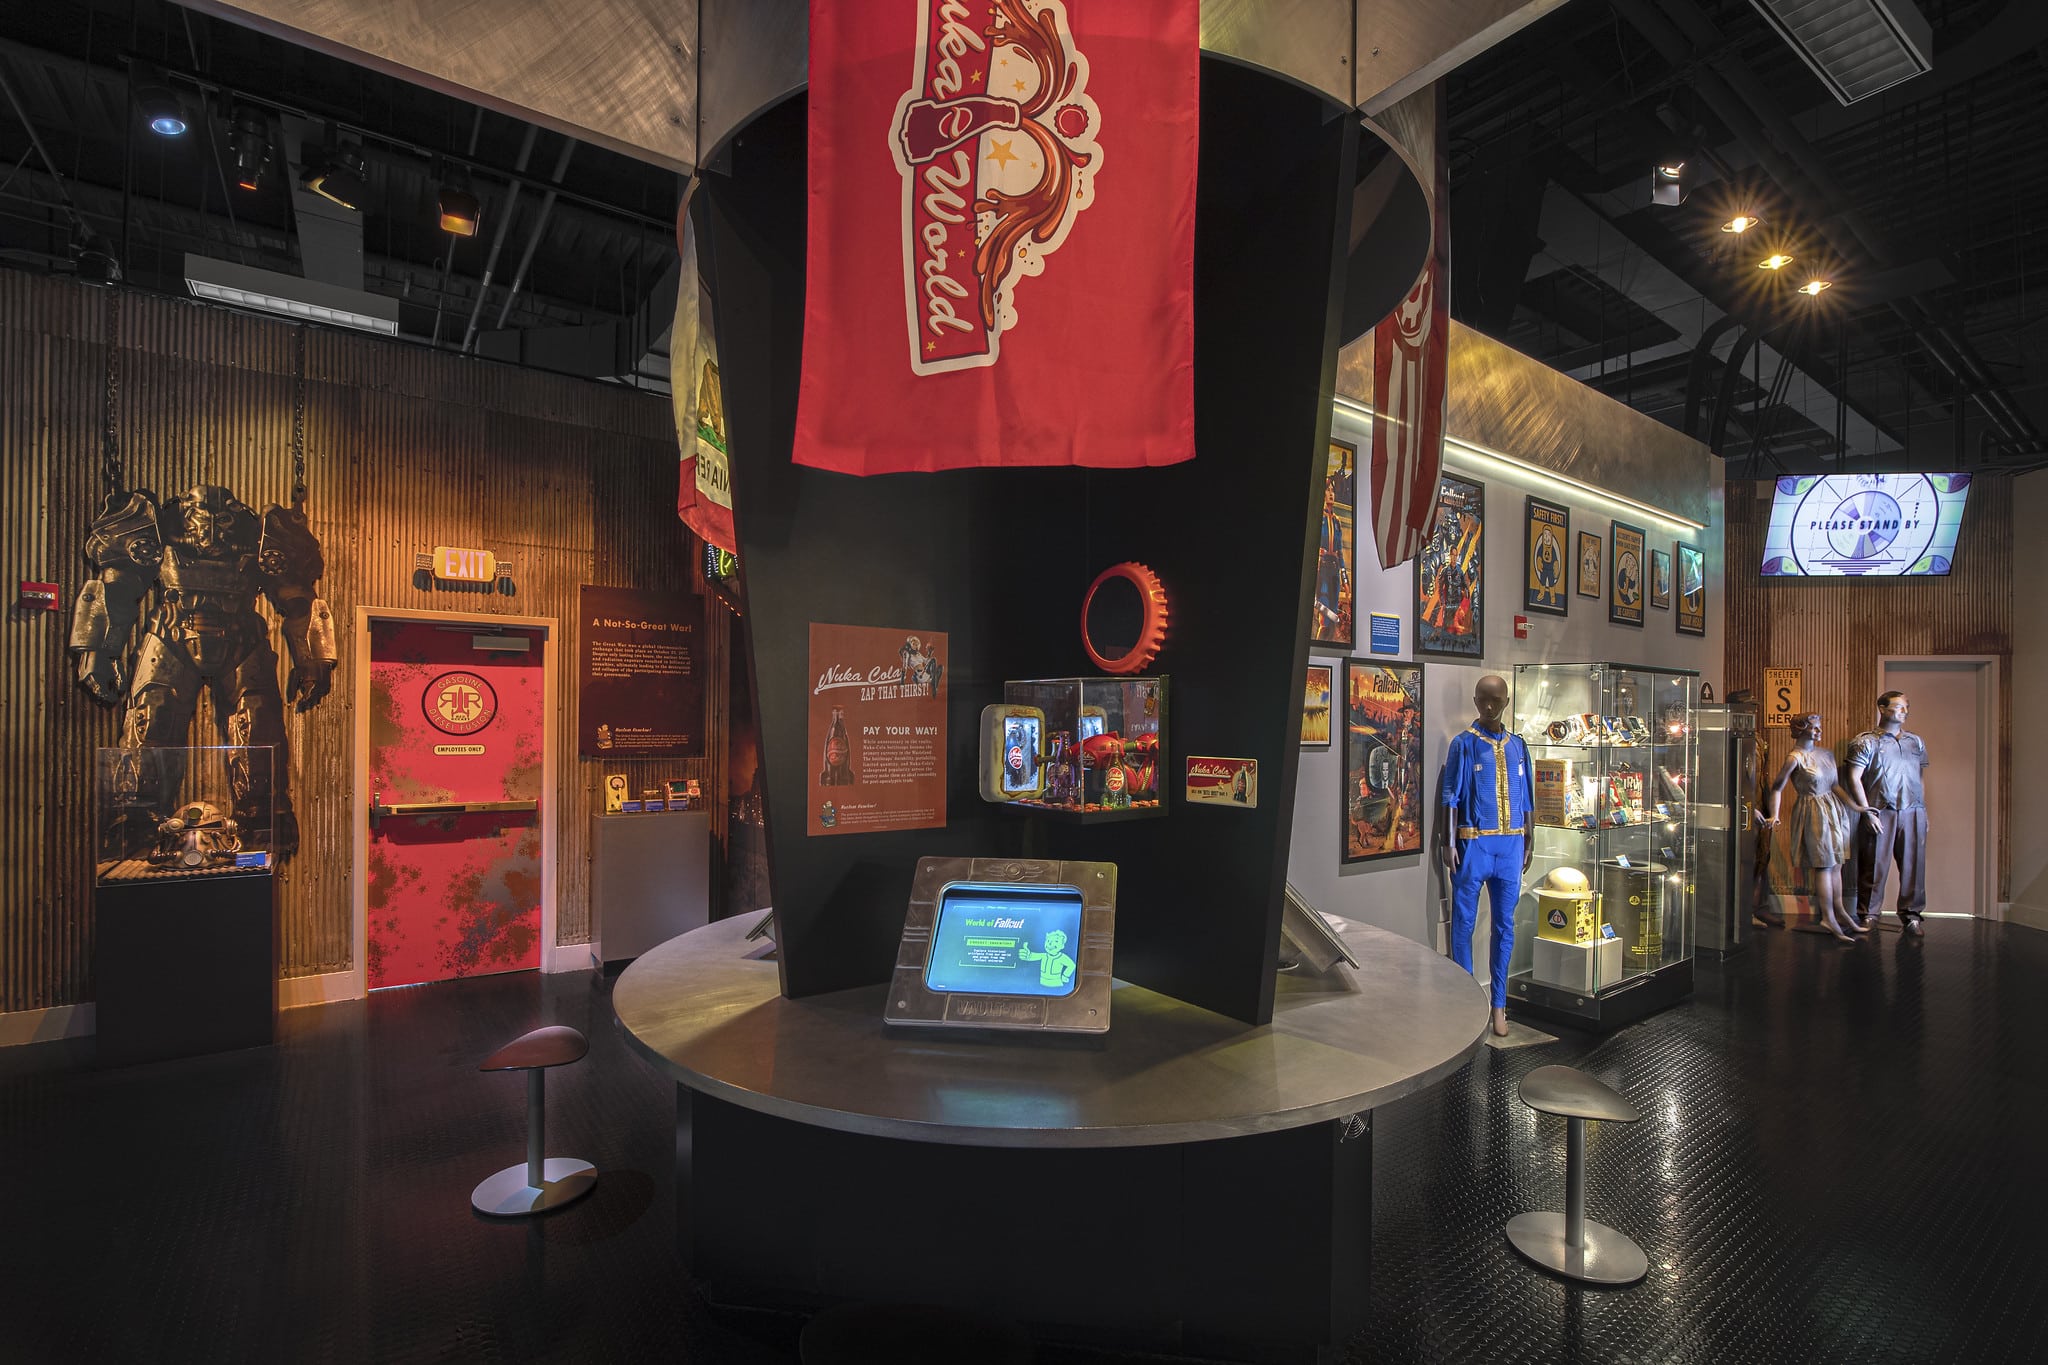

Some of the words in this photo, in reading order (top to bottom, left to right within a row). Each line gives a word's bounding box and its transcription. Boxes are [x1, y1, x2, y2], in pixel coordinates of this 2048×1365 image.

[923, 150, 974, 336] World
[1533, 507, 1549, 522] SAFETY
[1810, 520, 1853, 530] PLEASE
[1859, 519, 1899, 530] STAND
[1905, 519, 1920, 529] BY
[445, 549, 486, 579] EXIT
[592, 618, 600, 627] A
[604, 619, 667, 631] Not-So-Great
[670, 624, 692, 633] War!
[437, 676, 484, 689] GASOLINE
[818, 664, 862, 689] Nuka
[868, 665, 902, 684] Cola
[1768, 671, 1799, 679] SHELTER
[1372, 674, 1401, 693] Fallout
[1774, 679, 1793, 687] AREA
[861, 687, 876, 701] ZAP
[878, 685, 897, 700] THAT
[900, 683, 929, 698] THIRST!
[1776, 687, 1791, 713] S
[428, 708, 455, 731] DIESEL
[460, 709, 491, 732] FUSION
[1768, 713, 1800, 724] HER
[863, 727, 880, 735] PAY
[886, 727, 910, 735] YOUR
[915, 727, 938, 735] WAY!
[965, 918, 985, 927] World
[986, 919, 994, 927] of
[993, 917, 1025, 929] Fallout
